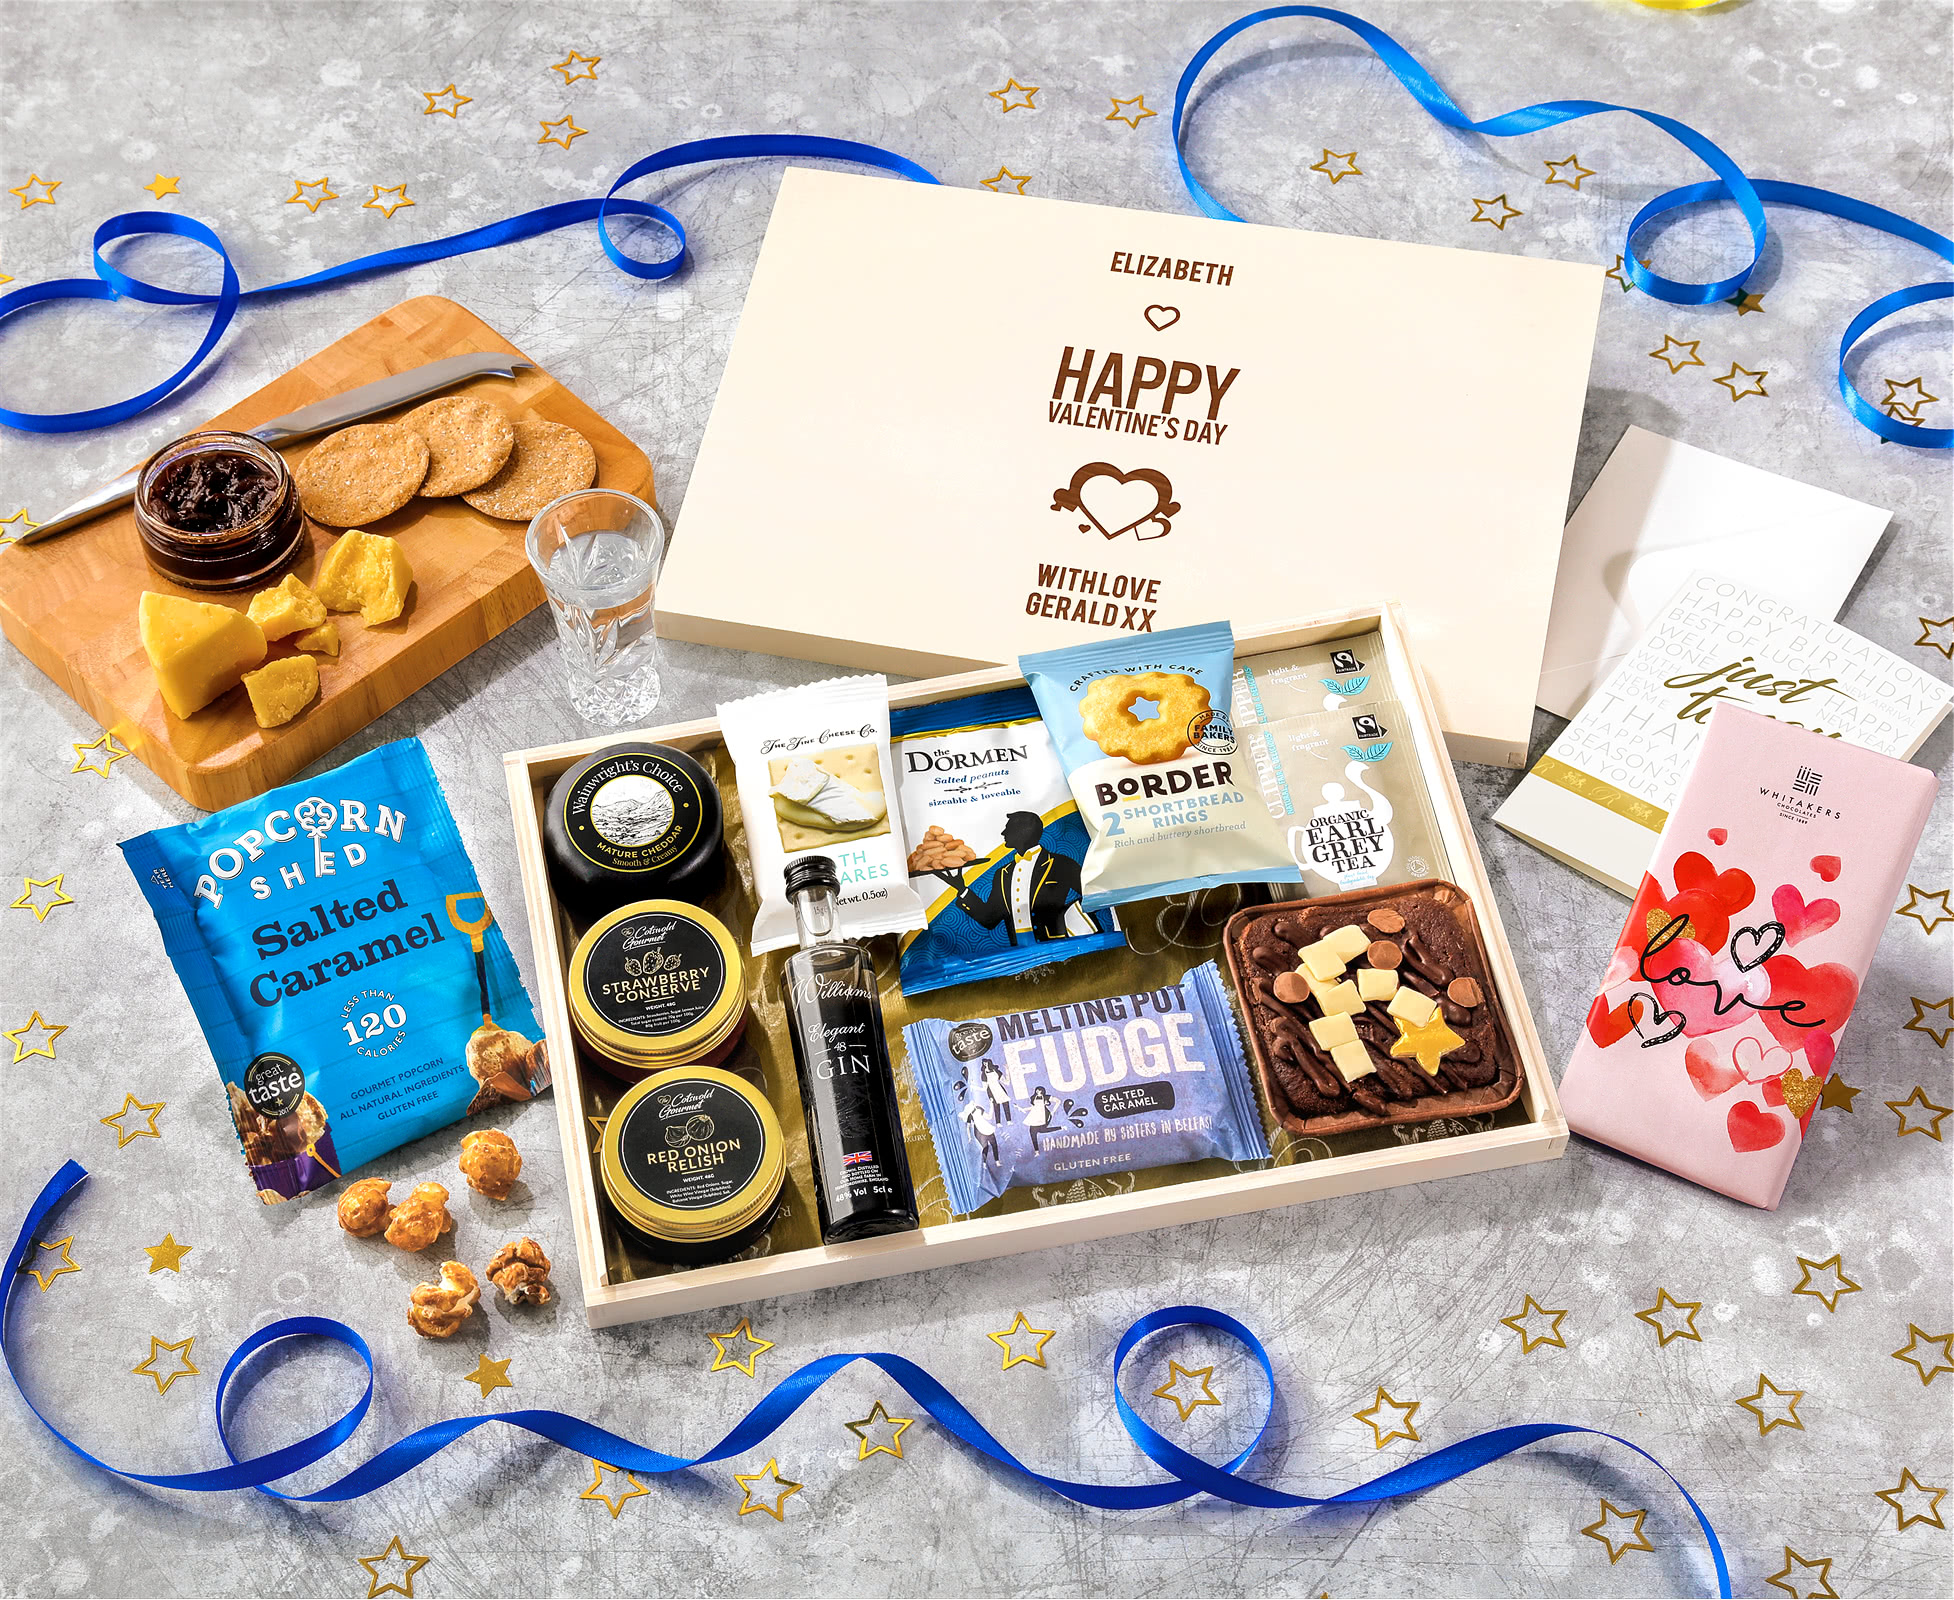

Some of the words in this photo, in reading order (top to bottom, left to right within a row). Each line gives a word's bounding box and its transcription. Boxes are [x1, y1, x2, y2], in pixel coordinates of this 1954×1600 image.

[1110, 251, 1234, 286] ELIZABETH
[1052, 346, 1241, 421] HAPPY
[1049, 401, 1180, 440] VALENTINE'S
[1183, 419, 1228, 445] DAY
[1025, 592, 1119, 626] GERALD
[1120, 606, 1157, 632] XX
[1648, 636, 1715, 670] DONE
[1660, 623, 1719, 657] WELL
[1667, 608, 1728, 640] BEST
[1727, 630, 1760, 647] OF
[1760, 644, 1821, 678] LUCK
[1696, 576, 1946, 701] CONGRATULATIONS
[1637, 650, 1682, 673] WITH
[1680, 592, 1783, 639] HAPPY
[1788, 635, 1934, 717] BIRTHDAY
[1069, 668, 1119, 692] CRAFTED
[1124, 663, 1163, 673] WITH
[1168, 663, 1204, 675] CARE
[1267, 665, 1290, 676] light
[1271, 672, 1309, 685] fragrant
[1618, 671, 1661, 693] NEW
[1628, 659, 1669, 680] LOVE
[1664, 656, 1857, 703] just
[1611, 679, 1672, 710] HOME
[1841, 682, 1872, 701] NEW
[1871, 699, 1918, 728] ARRIVAL
[1194, 724, 1233, 735] FAMILY
[1581, 713, 1660, 752] HAPPY
[1816, 708, 1856, 733] NEW
[1857, 728, 1896, 756] YEAR
[1824, 695, 1909, 743] HAPPY
[1193, 731, 1235, 744] BAKERS
[1288, 732, 1310, 742] light
[1292, 739, 1329, 752] fragrant
[905, 745, 1028, 774] DORMEN
[934, 748, 950, 758] the
[1569, 728, 1681, 786] SEASON'S
[934, 774, 967, 785] Salted
[969, 769, 1010, 785] peanuts
[1558, 744, 1592, 766] ON
[1599, 760, 1659, 798] YOUR
[572, 759, 640, 815] Wainwright's
[642, 761, 684, 794] Choice
[929, 796, 968, 808] sizeable
[970, 794, 979, 803] &
[981, 787, 1022, 802] loveable
[1102, 812, 1126, 837] 2
[1123, 791, 1245, 820] SHORTBREAD
[1760, 786, 1841, 820] WHITAKERS
[1777, 802, 1817, 818] CHOCOLATES
[1779, 812, 1795, 821] SINCE
[1153, 810, 1208, 829] RINGS
[1306, 818, 1385, 847] EARL
[1310, 809, 1370, 828] ORGANIC
[597, 842, 638, 859] MATURE
[641, 825, 684, 857] CHEDDAR
[1114, 836, 1135, 849] Rich
[1136, 833, 1155, 845] and
[1157, 828, 1192, 842] buttery
[1193, 821, 1247, 837] shortbread
[1312, 834, 1384, 863] GREY
[194, 797, 407, 909] POPCORN
[611, 857, 642, 868] Smooth
[643, 857, 650, 866] &
[651, 845, 678, 864] Creamy
[1332, 855, 1376, 874] TEA
[250, 842, 367, 899] SHED
[848, 894, 861, 903] wt.
[862, 887, 888, 901] 0.5oz)
[252, 878, 408, 960] Salted
[634, 920, 677, 940] Cotswold
[622, 932, 667, 951] Gourmet
[250, 912, 446, 1007] Caramel
[1639, 914, 1827, 1028] love
[602, 966, 710, 995] STRAWBERRY
[615, 979, 701, 1004] CONSERVE
[791, 973, 872, 1012] Williams
[341, 994, 360, 1018] LESS
[361, 989, 395, 1002] THAN
[995, 997, 1126, 1042] MELTING
[1133, 984, 1186, 1016] POT
[341, 1003, 407, 1047] 120
[808, 1022, 866, 1043] Elegant
[356, 1029, 407, 1058] CALORIES
[834, 1041, 847, 1052] 48
[952, 1029, 991, 1055] taste
[1003, 1012, 1206, 1100] FUDGE
[255, 1063, 283, 1085] great
[350, 1075, 397, 1101] GOURMET
[398, 1057, 444, 1082] POPCORN
[816, 1055, 871, 1080] GIN
[248, 1072, 302, 1103] taste
[339, 1108, 357, 1121] ALL
[358, 1091, 403, 1116] NATURAL
[404, 1065, 465, 1098] INGREDIENTS
[671, 1088, 715, 1107] Cotswold
[1101, 1088, 1145, 1104] SALTED
[377, 1098, 416, 1121] GLUTEN
[416, 1091, 439, 1107] FREE
[658, 1099, 705, 1119] Gourmet
[1103, 1098, 1158, 1113] CARAMEL
[647, 1149, 680, 1165] RED
[684, 1138, 741, 1158] ONION
[1042, 1129, 1100, 1152] HANDMADE
[1104, 1127, 1117, 1143] BY
[667, 1152, 724, 1173] RELISH
[1054, 1158, 1100, 1171] GLUTEN
[1103, 1153, 1132, 1165] FREE
[836, 1190, 852, 1203] 48%
[853, 1187, 867, 1197] Vol
[873, 1186, 886, 1194] 5cl
